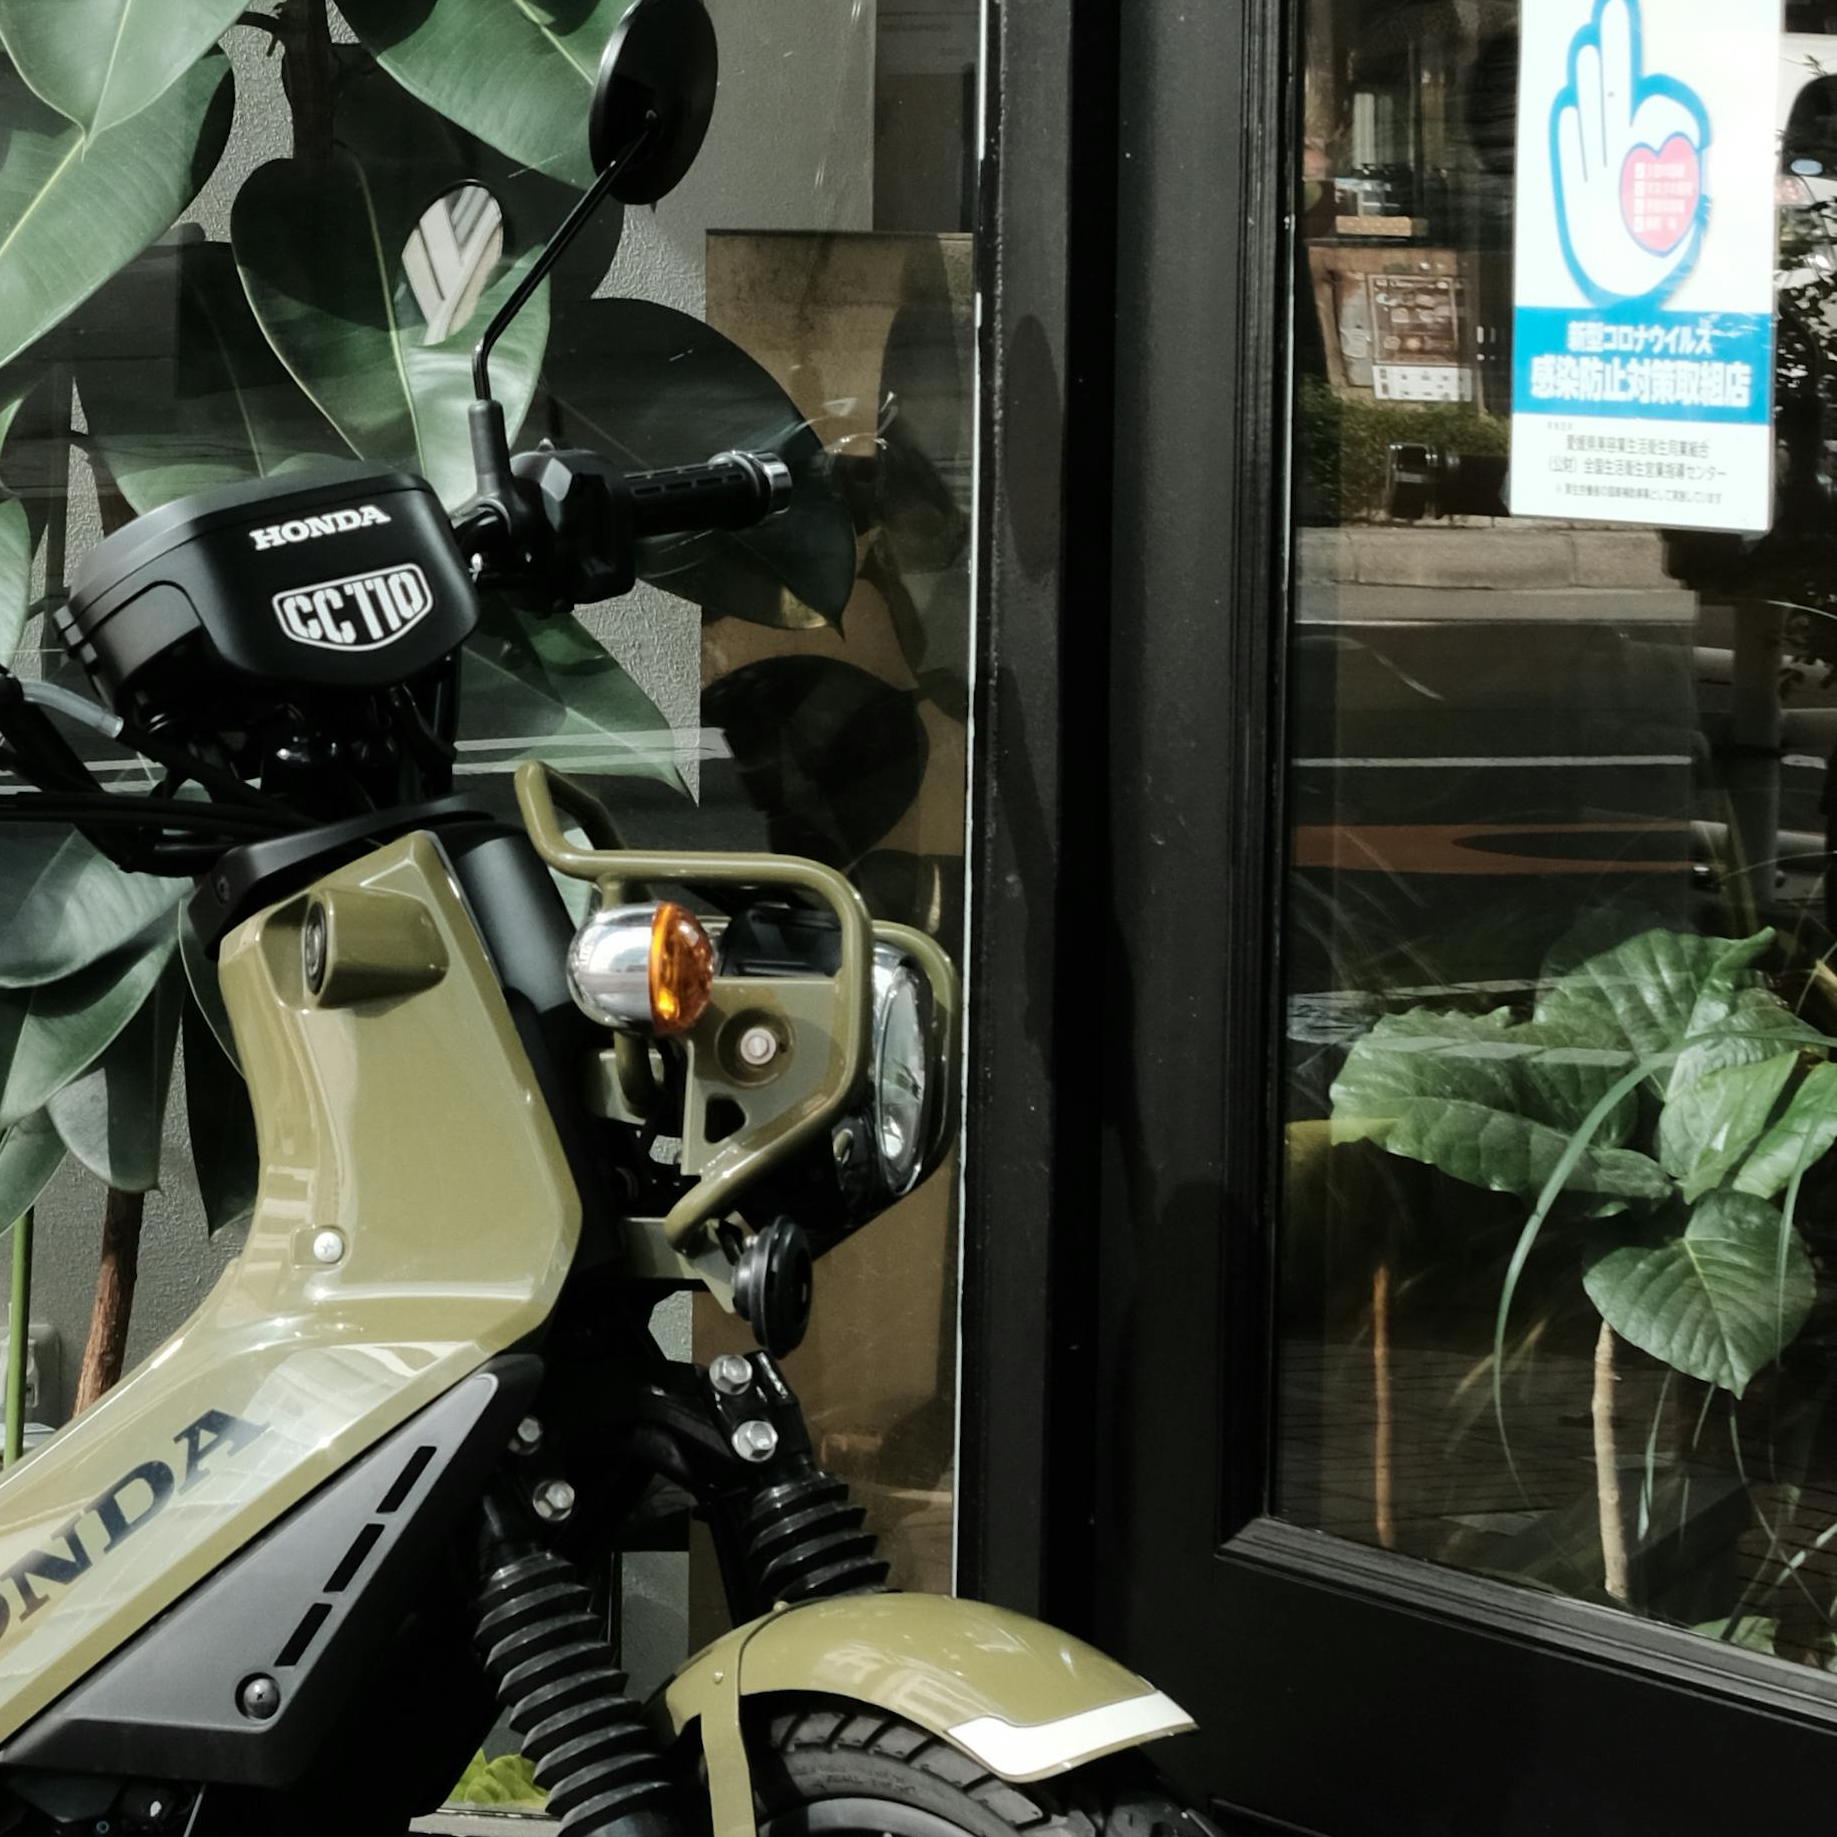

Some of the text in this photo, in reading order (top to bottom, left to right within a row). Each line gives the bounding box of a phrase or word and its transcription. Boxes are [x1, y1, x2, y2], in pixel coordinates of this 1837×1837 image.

[1567, 320, 1715, 354] 新型コロナウイルス
[1531, 354, 1752, 408] 感染防止対策取組店
[249, 504, 392, 551] HONDA
[282, 571, 425, 645] CC110
